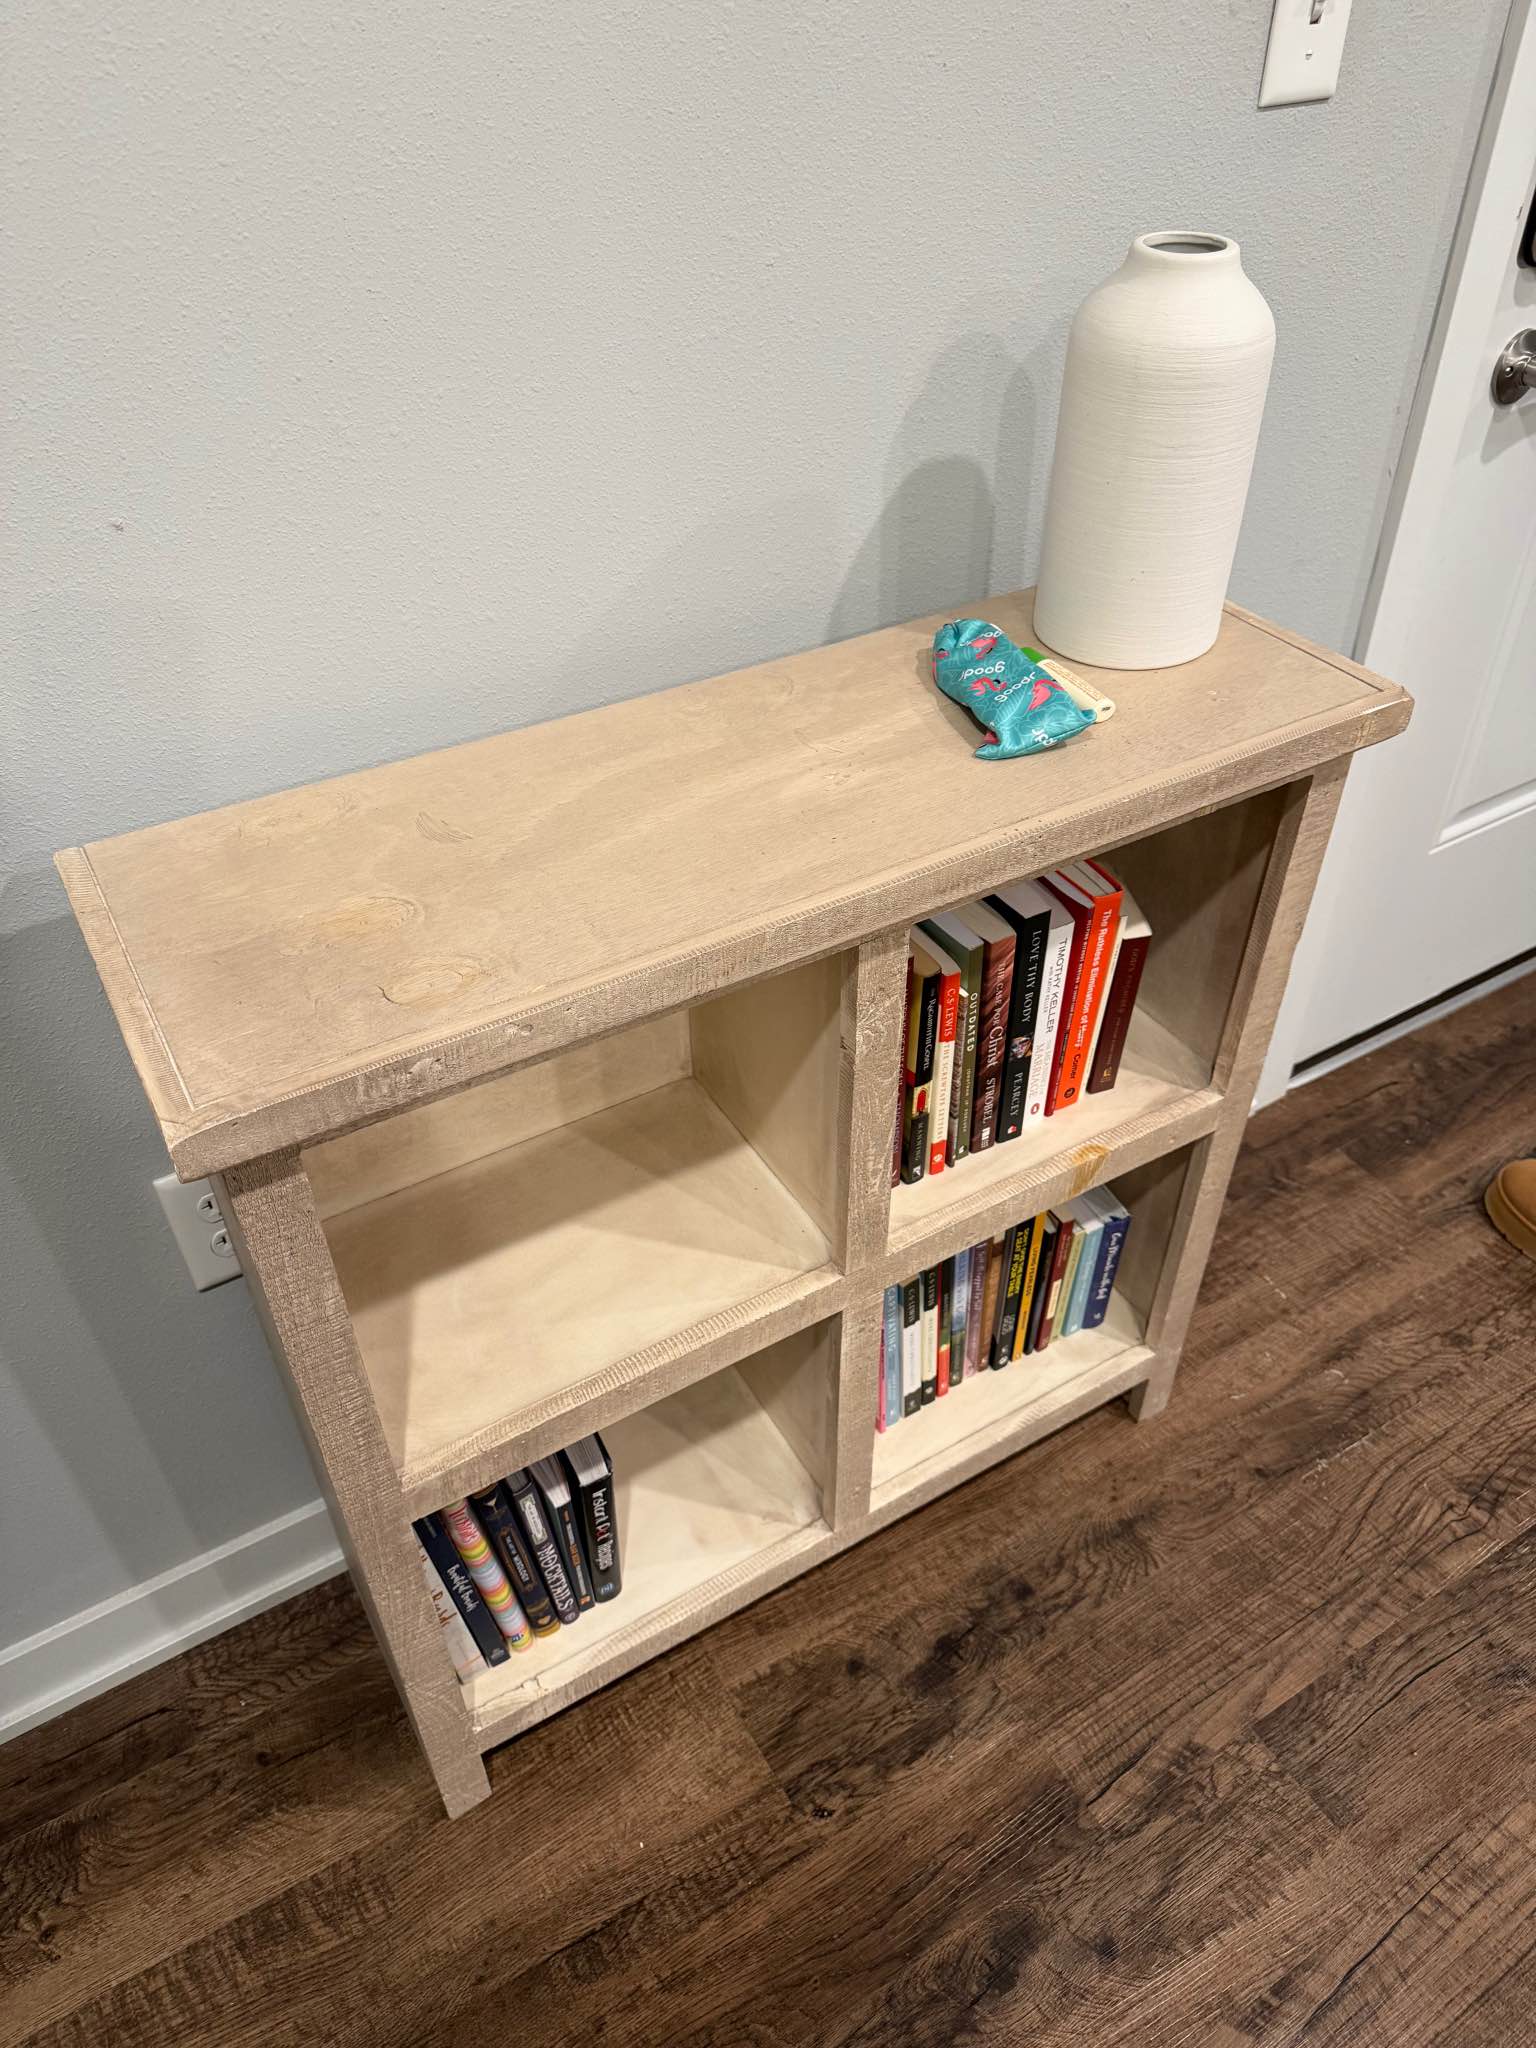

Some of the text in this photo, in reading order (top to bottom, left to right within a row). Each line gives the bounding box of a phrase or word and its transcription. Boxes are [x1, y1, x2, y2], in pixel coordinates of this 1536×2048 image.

[994, 671, 1036, 703] goodr
[1100, 908, 1111, 928] The
[1092, 927, 1107, 966] Ruthless
[1021, 929, 1042, 1023] LOVE THY BODY
[1045, 936, 1067, 1034] TIMOTHY KELLER
[1082, 967, 1099, 1015] Elimination
[943, 1007, 954, 1037] LEWIS
[966, 992, 978, 1052] OUTDATED
[1079, 1014, 1088, 1024] of
[985, 1025, 1004, 1069] Christ
[1069, 1053, 1081, 1080] Comer
[982, 1077, 995, 1124] STROBEL
[1009, 1071, 1023, 1116] PEARCEY
[887, 1288, 896, 1351] CAPTIVATING
[592, 1488, 608, 1524] Instant
[595, 1522, 610, 1541] Pot
[538, 1544, 574, 1611] MOCKTAILS
